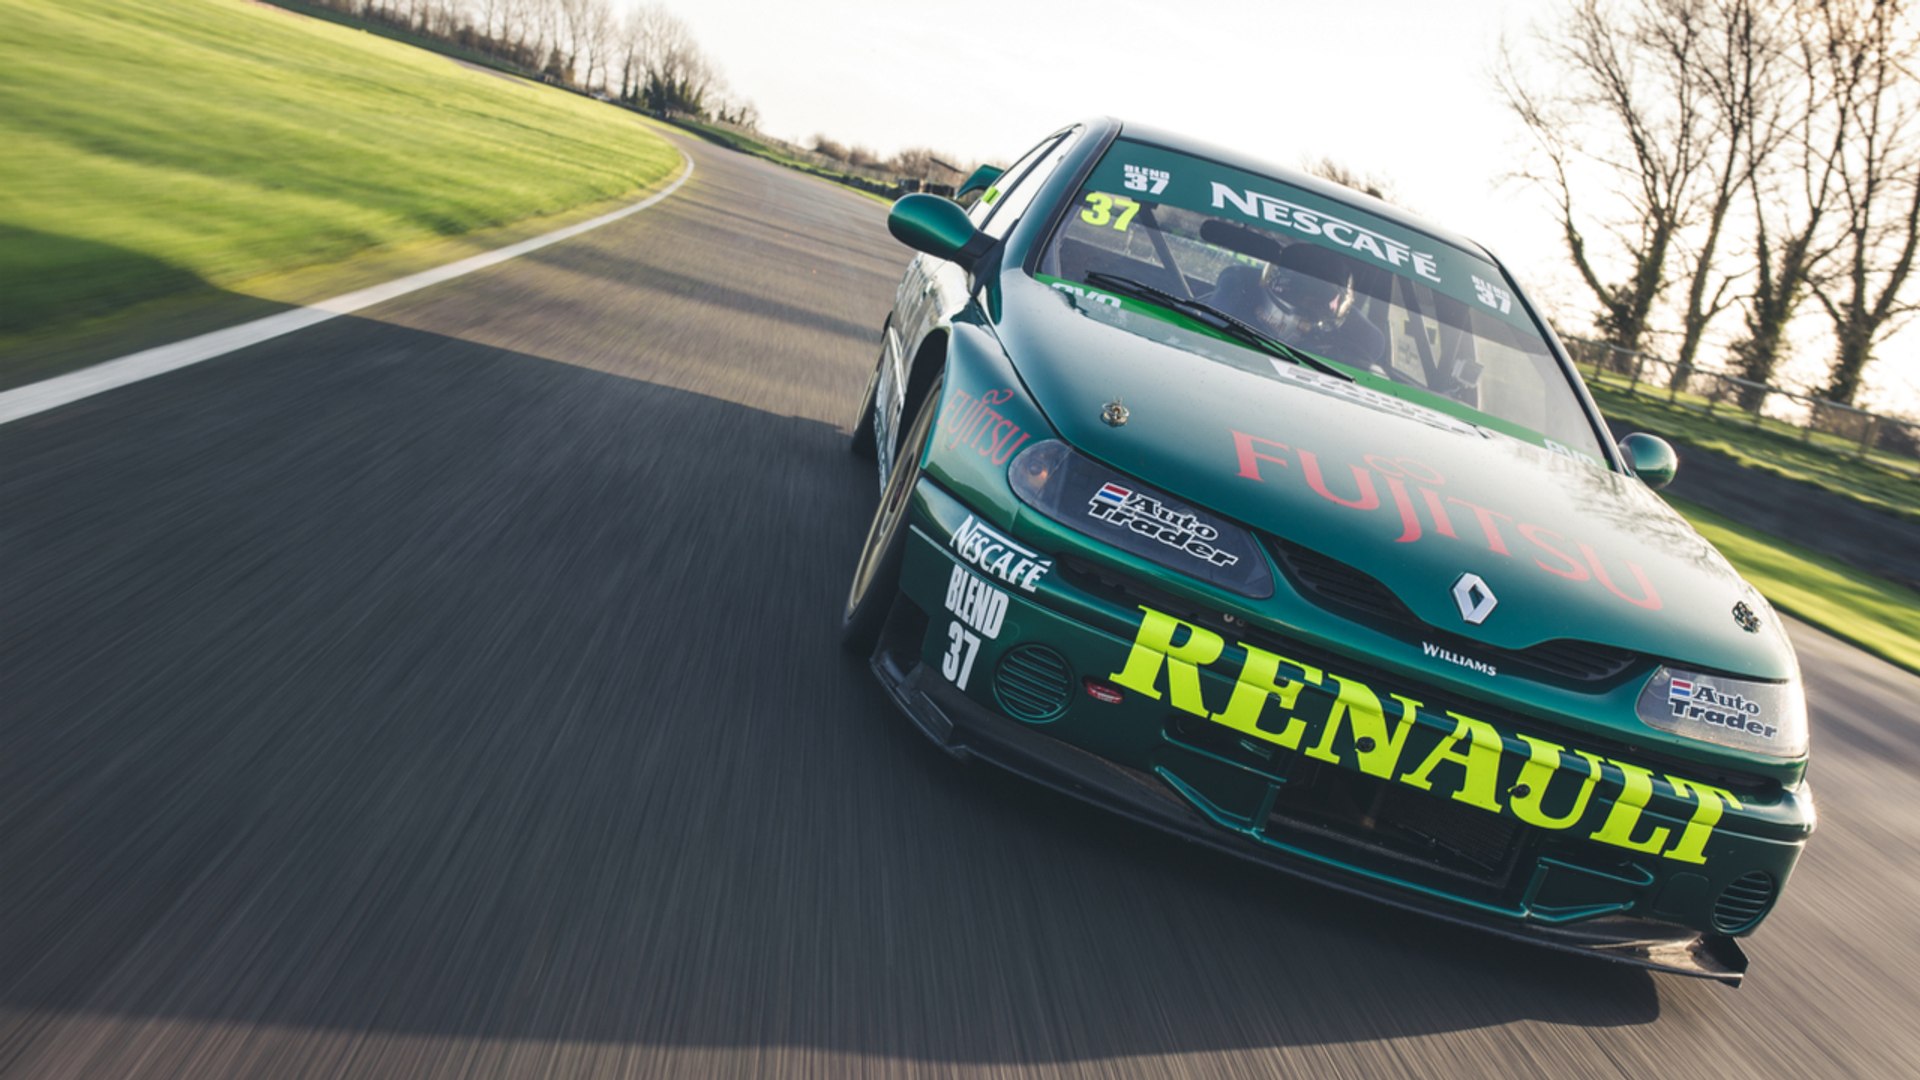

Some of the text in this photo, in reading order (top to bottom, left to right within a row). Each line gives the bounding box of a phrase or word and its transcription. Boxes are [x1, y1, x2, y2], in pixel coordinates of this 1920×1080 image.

[1123, 164, 1170, 180] BLEND
[1123, 172, 1169, 195] 37
[1080, 192, 1141, 232] 37
[1210, 181, 1442, 283] NESCAFÉ
[1474, 284, 1511, 315] 37
[937, 388, 1032, 465] FUJITSU
[1088, 499, 1239, 567] Trader
[1128, 493, 1219, 541] Auto
[1230, 428, 1663, 611] FUJITSU
[948, 515, 1053, 593] NESCAFÉ
[944, 564, 1010, 641] BLEND
[941, 620, 981, 692] 37
[1421, 640, 1498, 677] WILLIAMS
[1668, 697, 1779, 739] Trader
[1693, 683, 1761, 716] Auto
[1108, 604, 1743, 865] RENAULT
